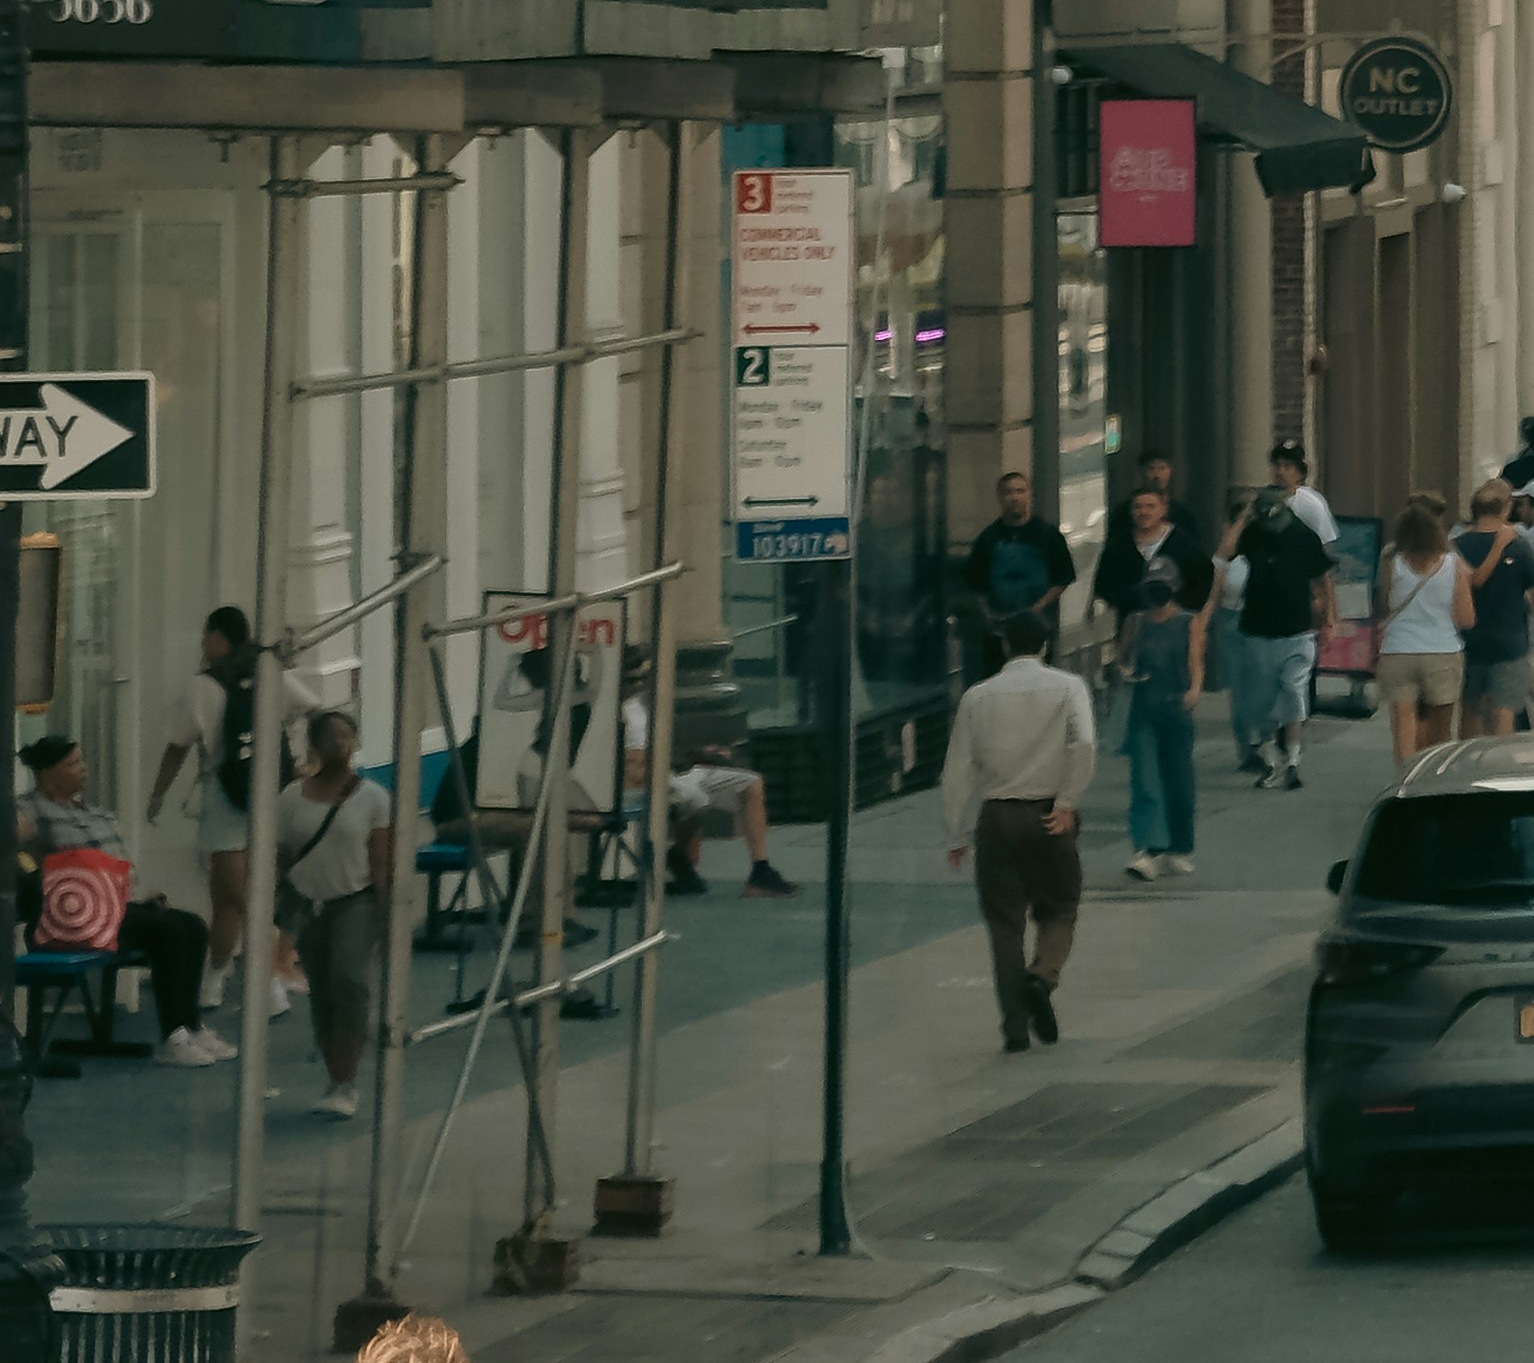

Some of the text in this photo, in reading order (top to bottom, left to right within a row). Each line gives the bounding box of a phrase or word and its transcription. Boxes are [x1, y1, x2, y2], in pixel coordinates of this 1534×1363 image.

[1370, 67, 1421, 95] NC
[1354, 96, 1440, 116] OUTLET
[743, 176, 763, 211] 3
[743, 349, 765, 384] 2
